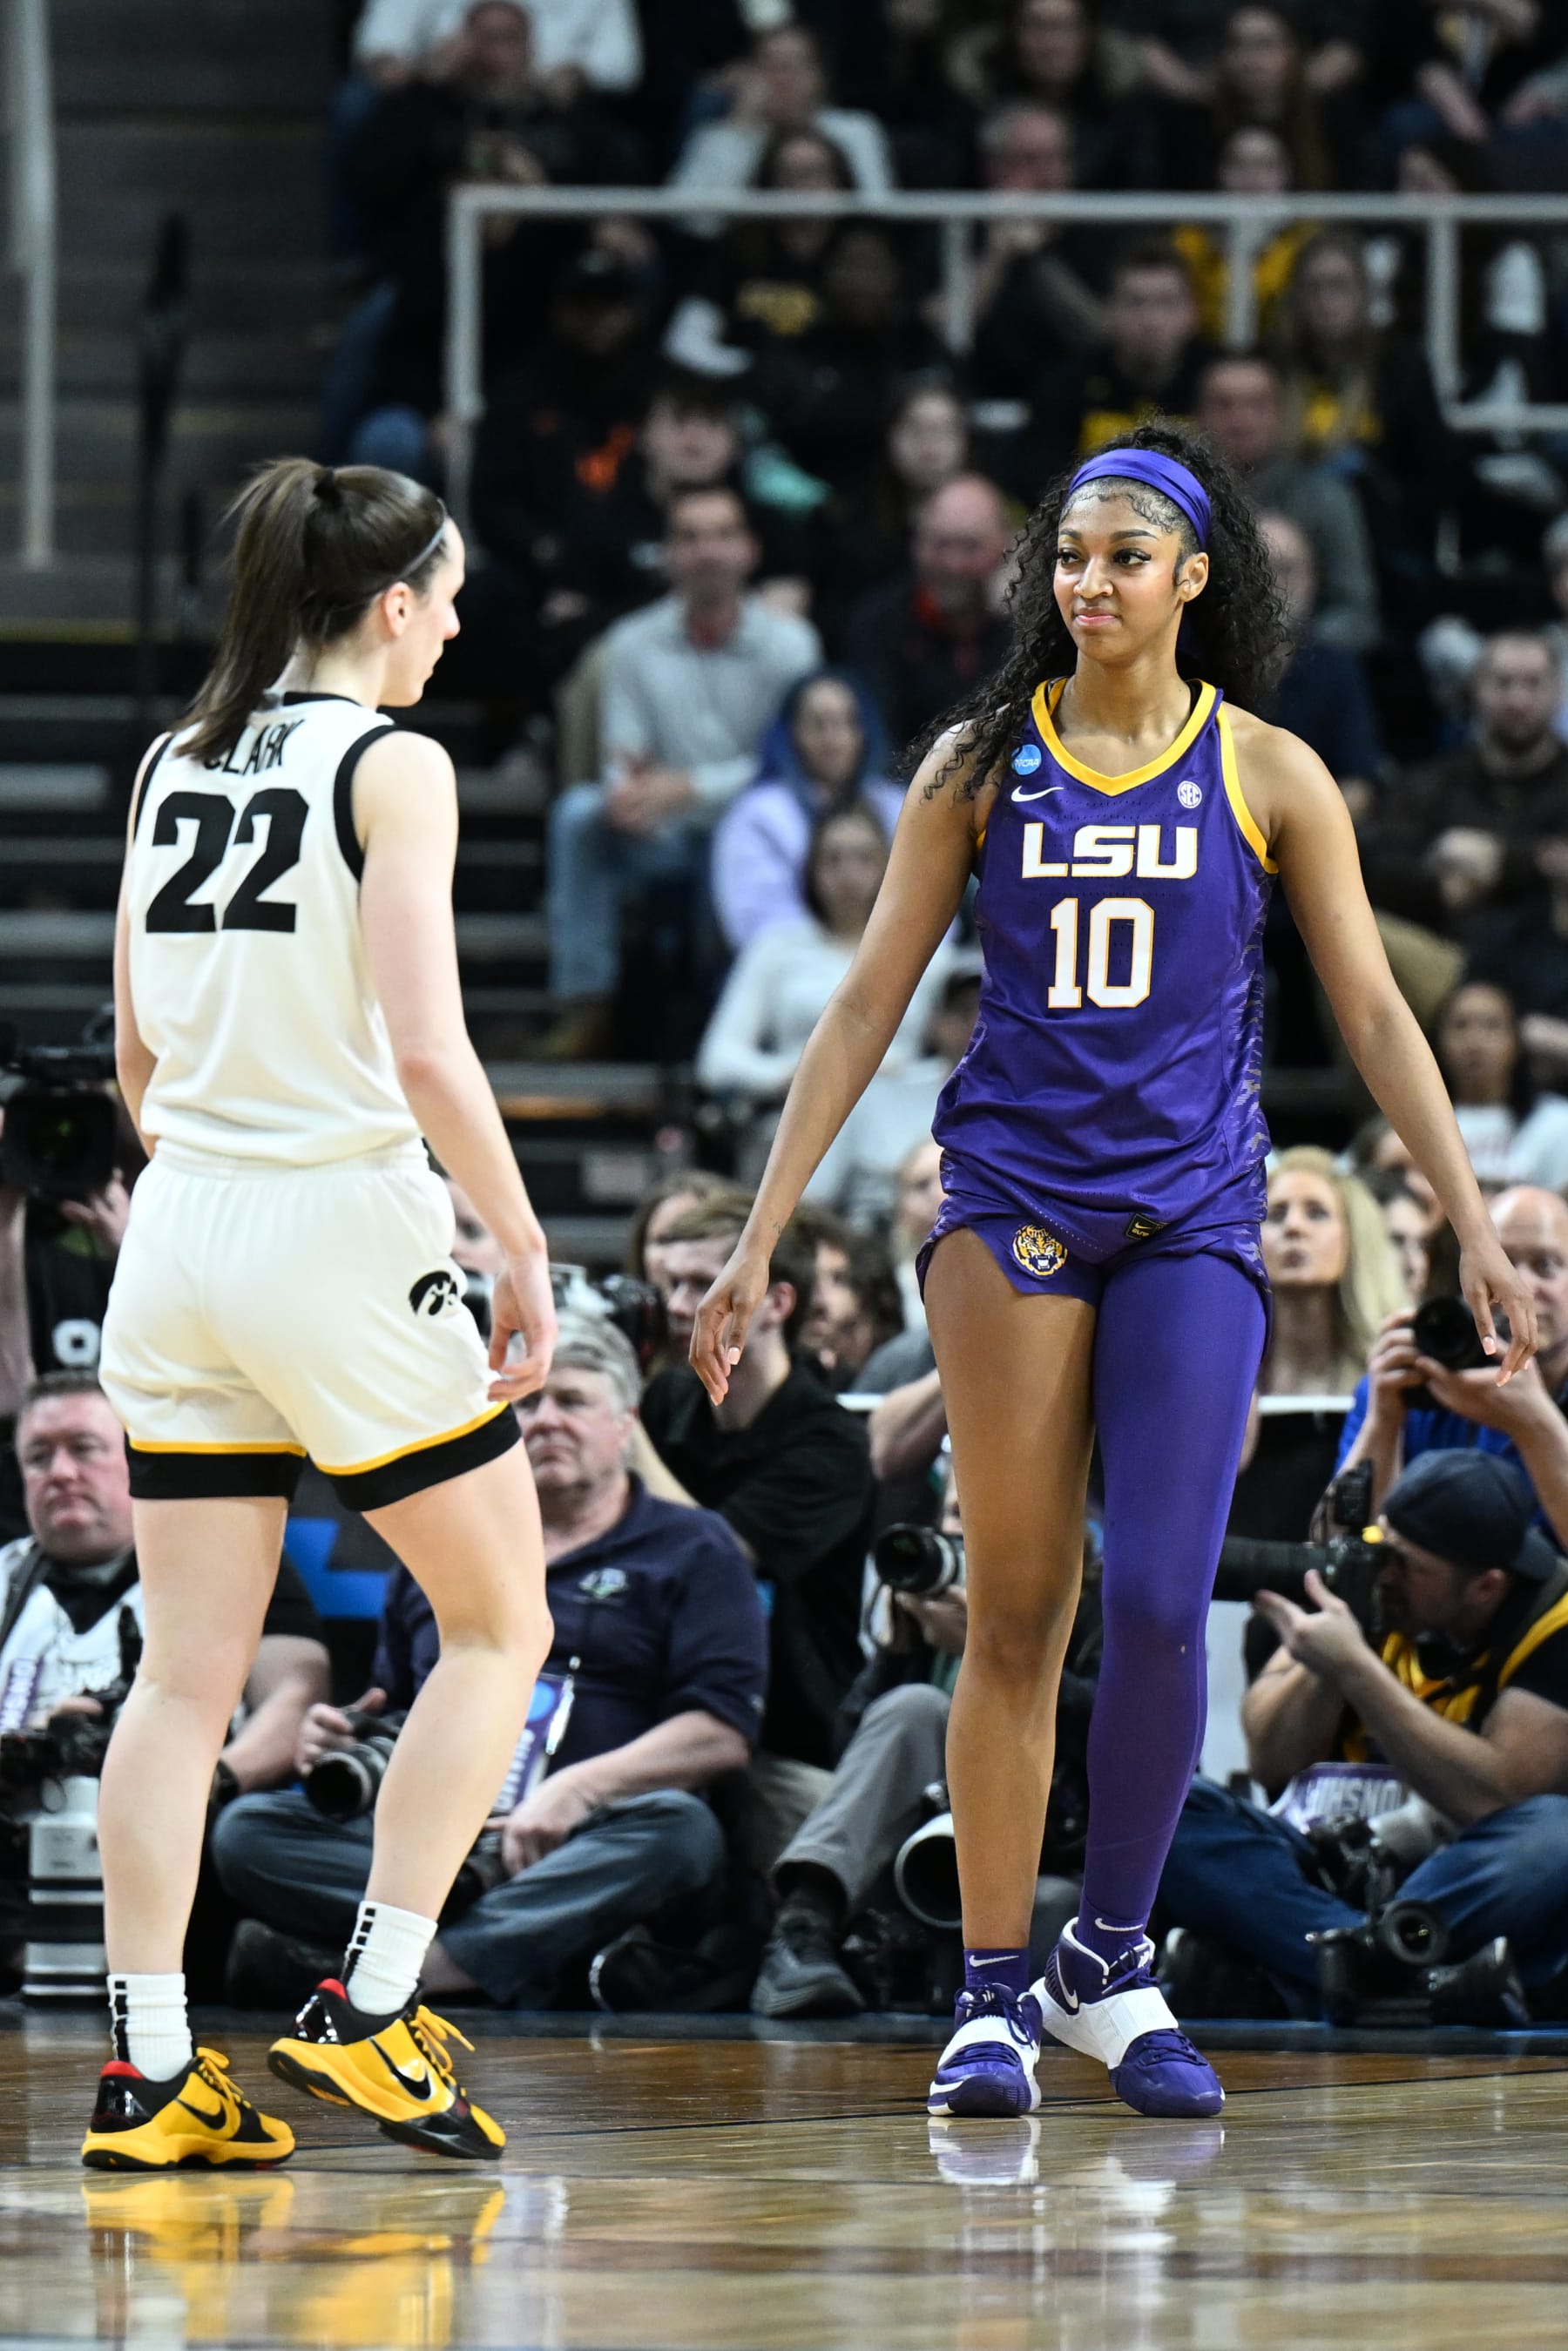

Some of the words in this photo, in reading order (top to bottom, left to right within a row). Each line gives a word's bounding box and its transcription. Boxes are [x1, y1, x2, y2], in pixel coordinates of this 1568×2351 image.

[1180, 783, 1200, 806] SEC
[145, 787, 309, 934] 22
[1021, 822, 1198, 880] LSU
[1047, 897, 1155, 1009] 10
